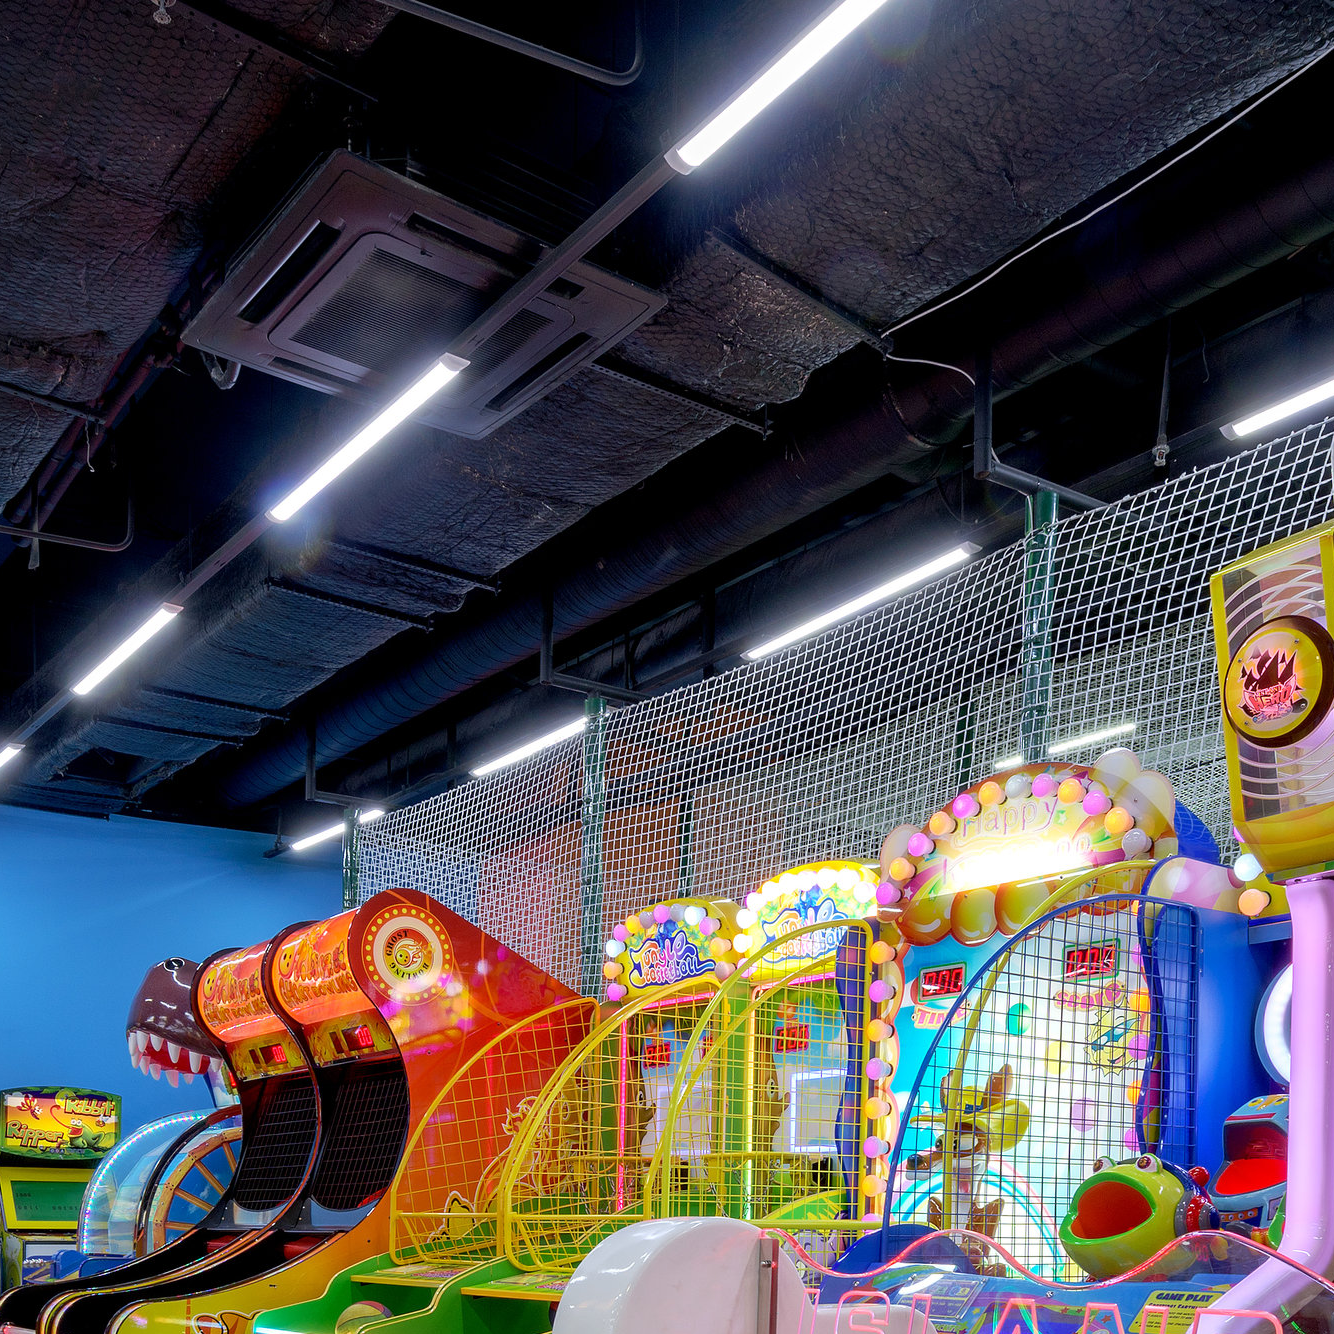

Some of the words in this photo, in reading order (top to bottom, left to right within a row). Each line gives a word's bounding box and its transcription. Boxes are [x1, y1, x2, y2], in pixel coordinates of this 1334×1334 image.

[1249, 686, 1293, 708] HERO
[385, 929, 409, 956] GHOST
[64, 1096, 115, 1117] Ribbit
[5, 1120, 64, 1148] Ripper
[1155, 1292, 1185, 1302] GAME
[1185, 1293, 1214, 1303] PLAY
